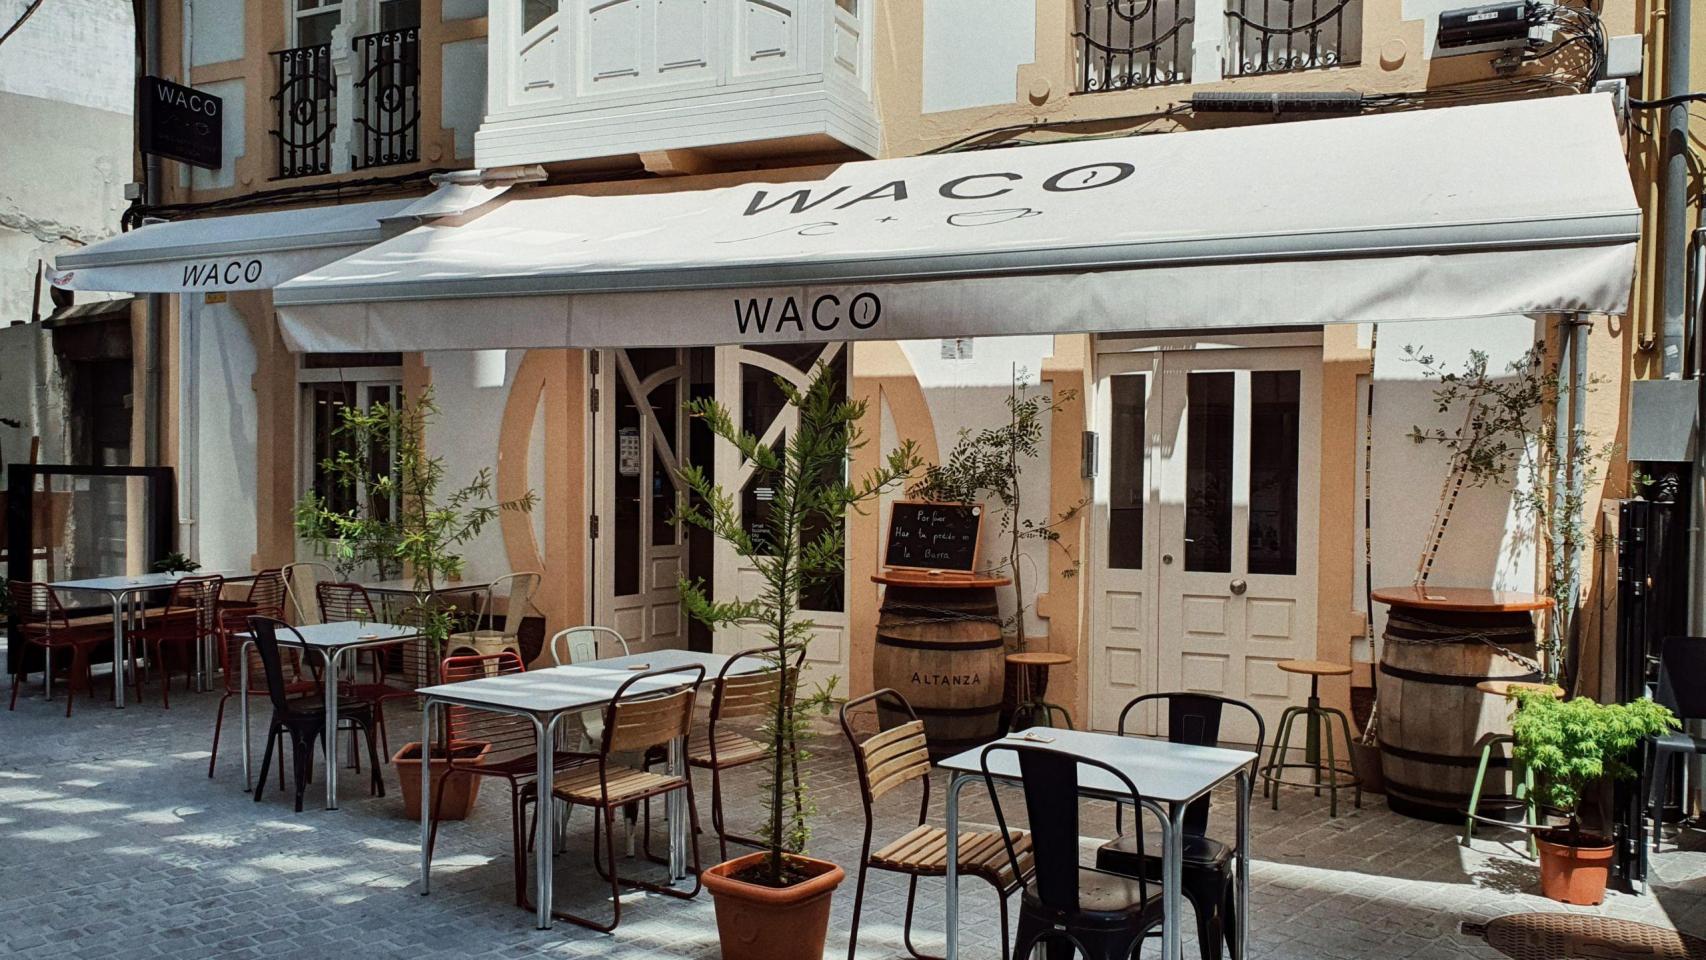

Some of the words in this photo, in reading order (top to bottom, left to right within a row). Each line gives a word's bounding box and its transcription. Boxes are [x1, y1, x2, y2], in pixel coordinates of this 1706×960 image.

[158, 84, 216, 116] WACO
[743, 162, 1136, 217] WACO
[183, 259, 263, 287] WACO
[734, 291, 882, 334] WACO
[917, 510, 929, 521] Por
[924, 548, 951, 559] Barra
[911, 672, 981, 686] ALTANZA
